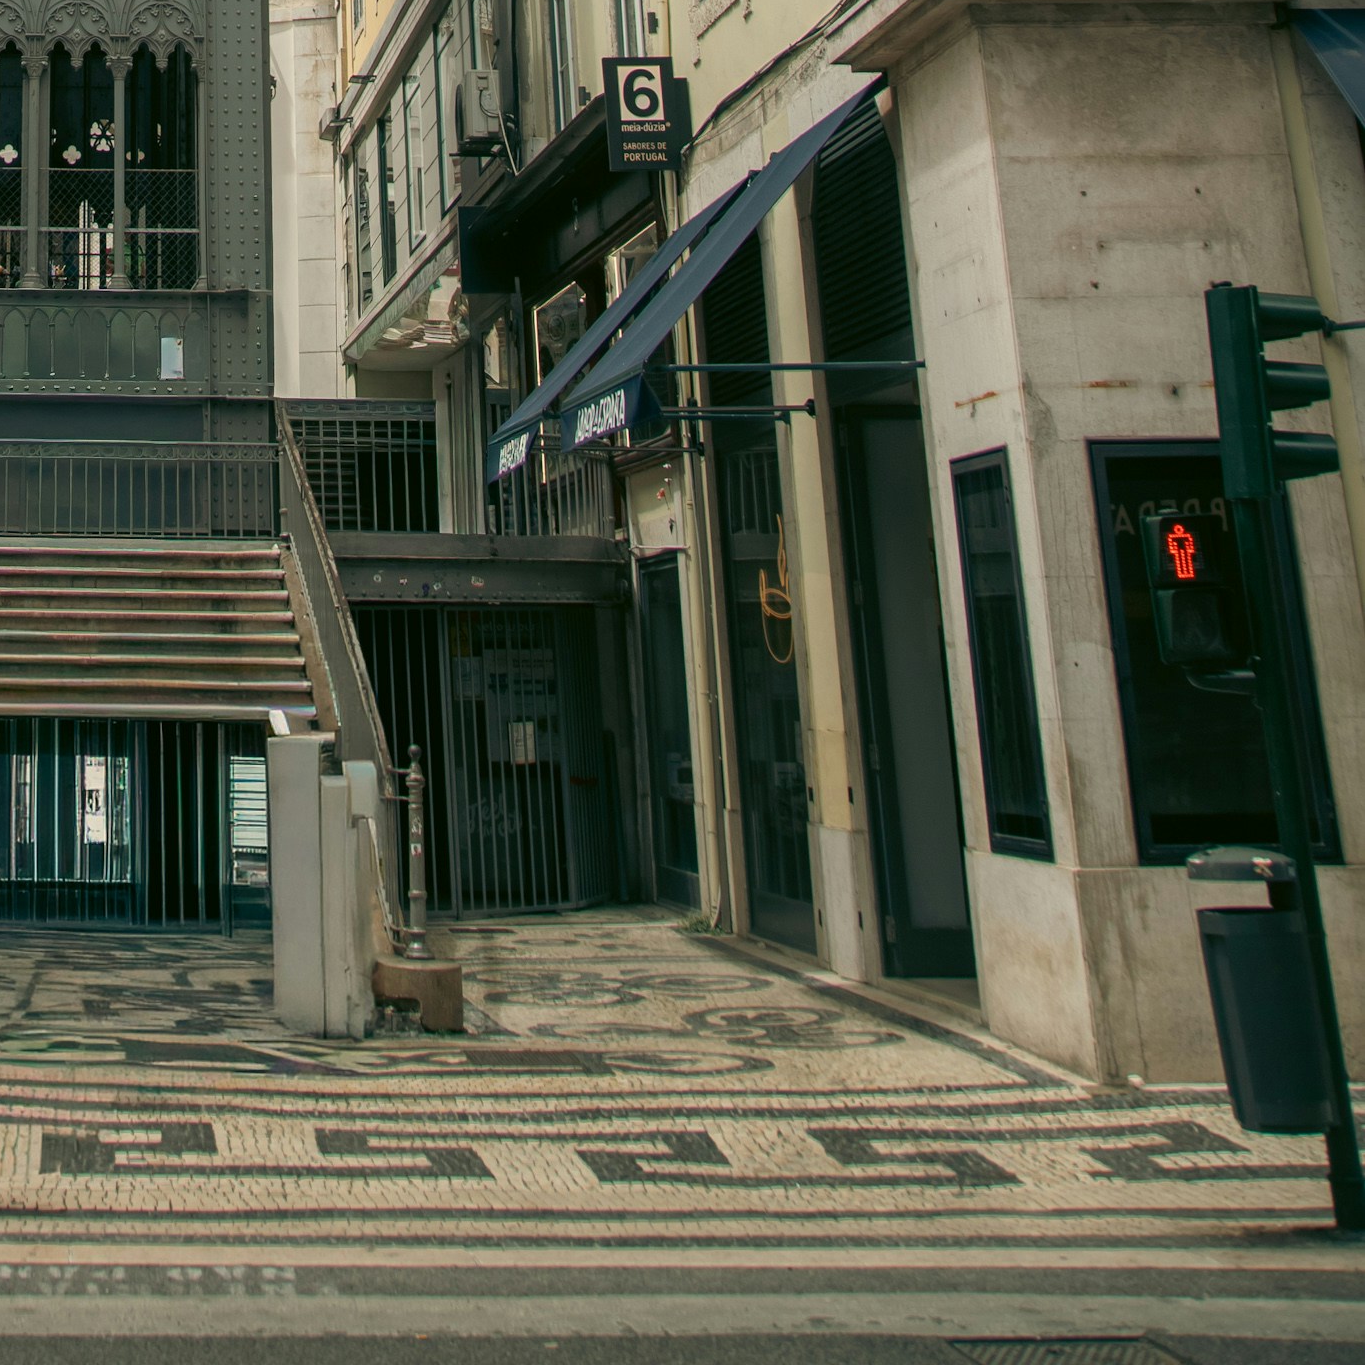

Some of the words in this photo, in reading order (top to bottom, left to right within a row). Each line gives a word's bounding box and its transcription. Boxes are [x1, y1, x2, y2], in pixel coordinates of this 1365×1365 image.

[623, 68, 659, 118] 6
[623, 142, 655, 150] SABORES
[658, 142, 667, 150] DE
[624, 153, 667, 161] PORTUGAL
